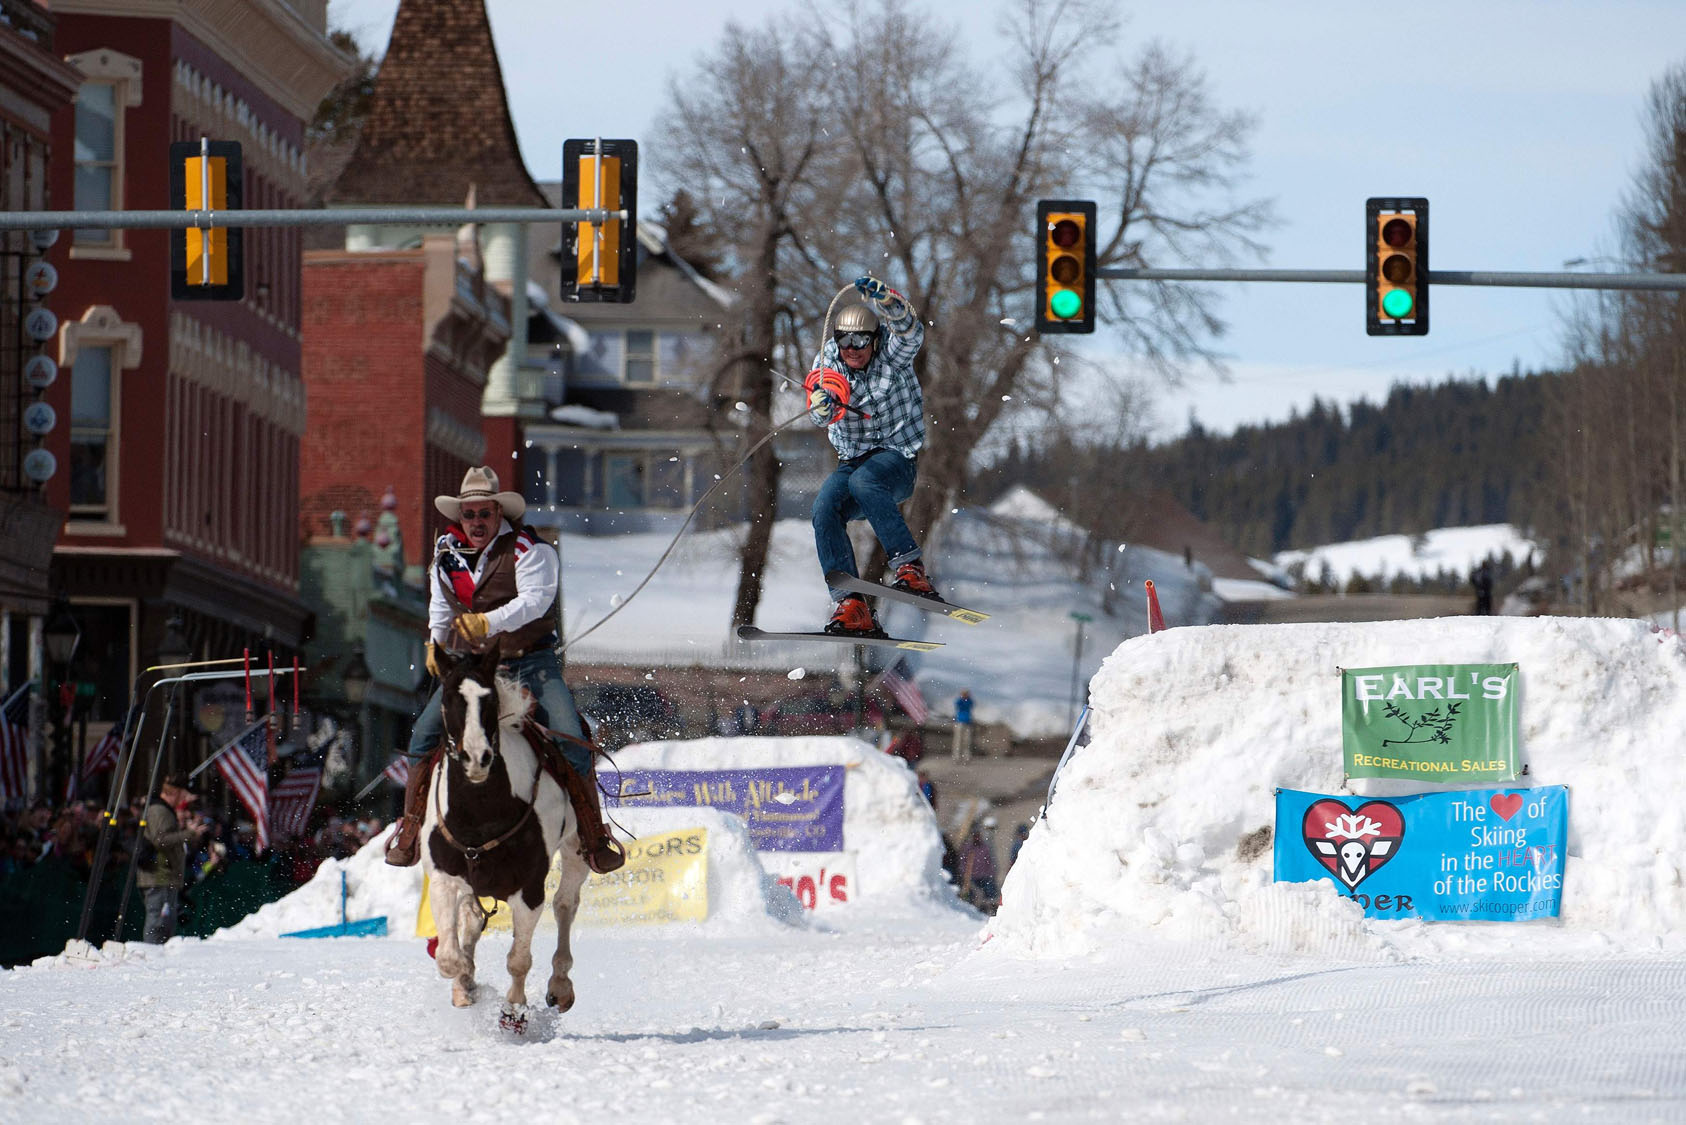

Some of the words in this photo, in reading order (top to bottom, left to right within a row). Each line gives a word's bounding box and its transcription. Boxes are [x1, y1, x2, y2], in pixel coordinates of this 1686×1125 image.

[1355, 672, 1508, 701] EARL'S
[1353, 753, 1459, 772] RECREATIONAL
[1461, 759, 1507, 772] SALES
[1451, 801, 1486, 822] The
[1528, 796, 1548, 819] of
[1471, 825, 1527, 848] Skiing
[1441, 853, 1458, 872] in
[1464, 851, 1494, 871] the
[1498, 844, 1557, 868] HEART
[1433, 875, 1454, 895] of
[1457, 874, 1487, 895] the
[1493, 870, 1561, 893] Rockies
[1439, 899, 1557, 917] www.skicooper.com
